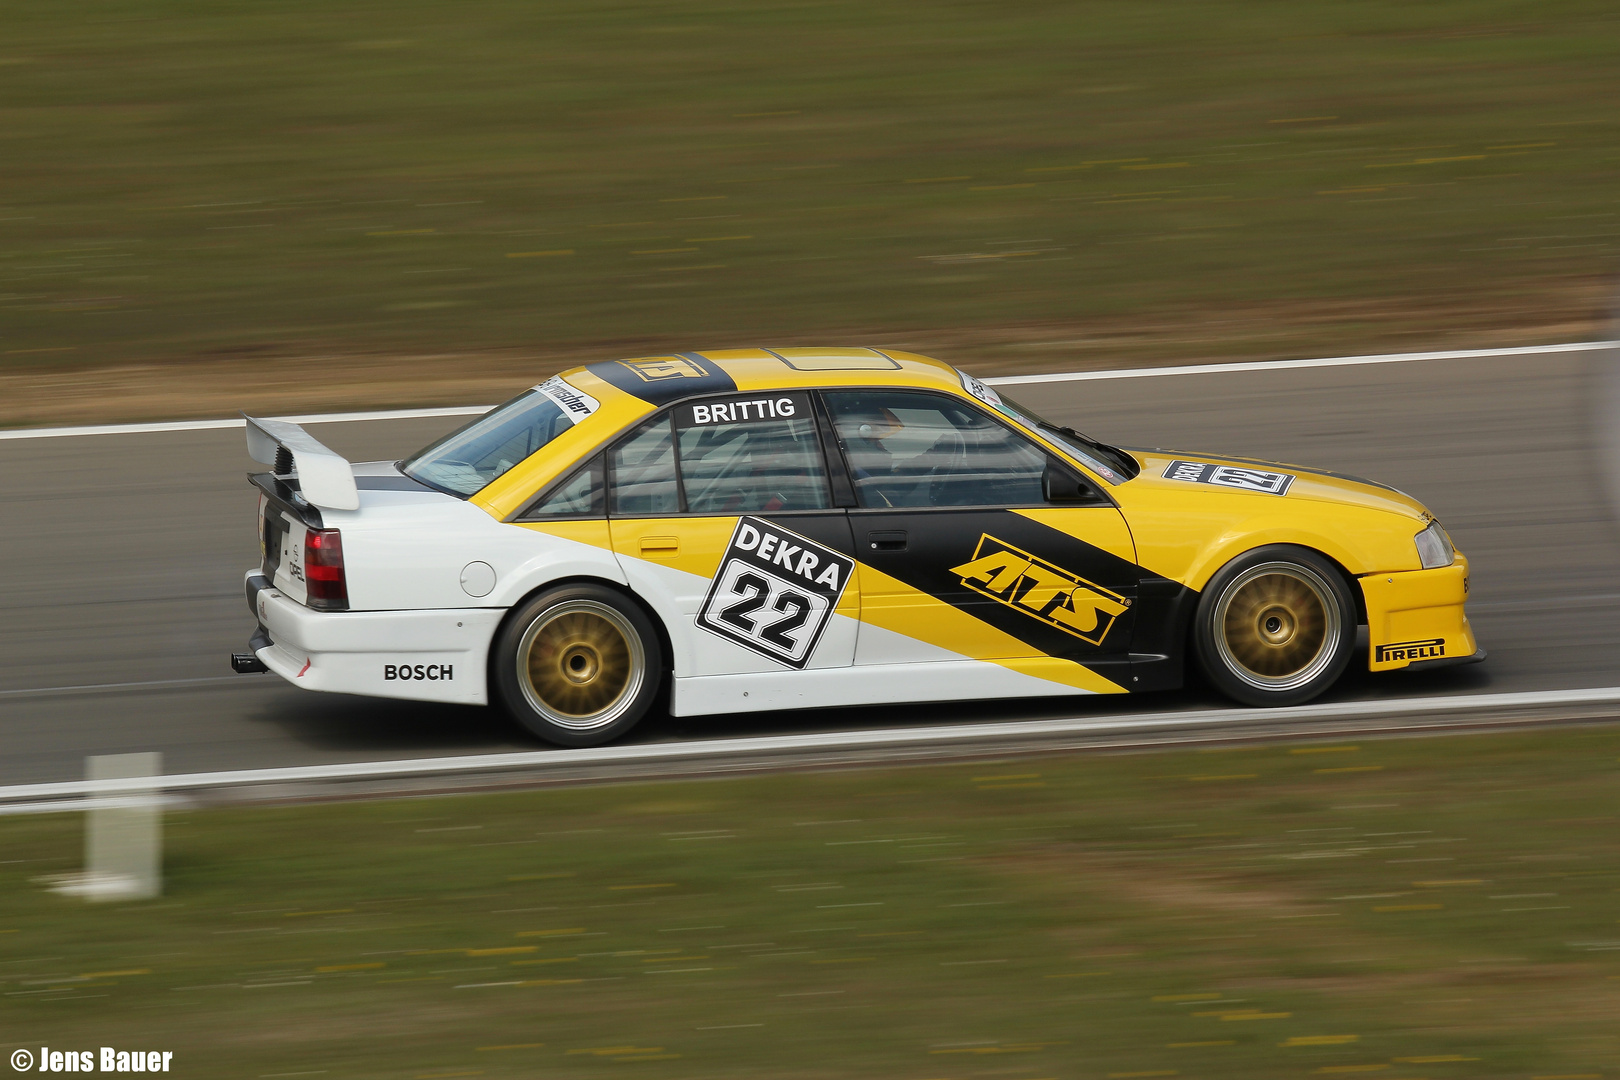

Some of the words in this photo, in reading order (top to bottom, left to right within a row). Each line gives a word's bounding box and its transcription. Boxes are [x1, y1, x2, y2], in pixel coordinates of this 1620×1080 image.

[693, 398, 796, 424] BRITTIG
[1172, 462, 1207, 482] DEKRA
[735, 523, 840, 591] DEKRA
[948, 550, 1129, 633] ATS
[717, 571, 814, 653] 22
[1375, 638, 1446, 662] PIRELLI
[384, 664, 453, 681] BOSCH
